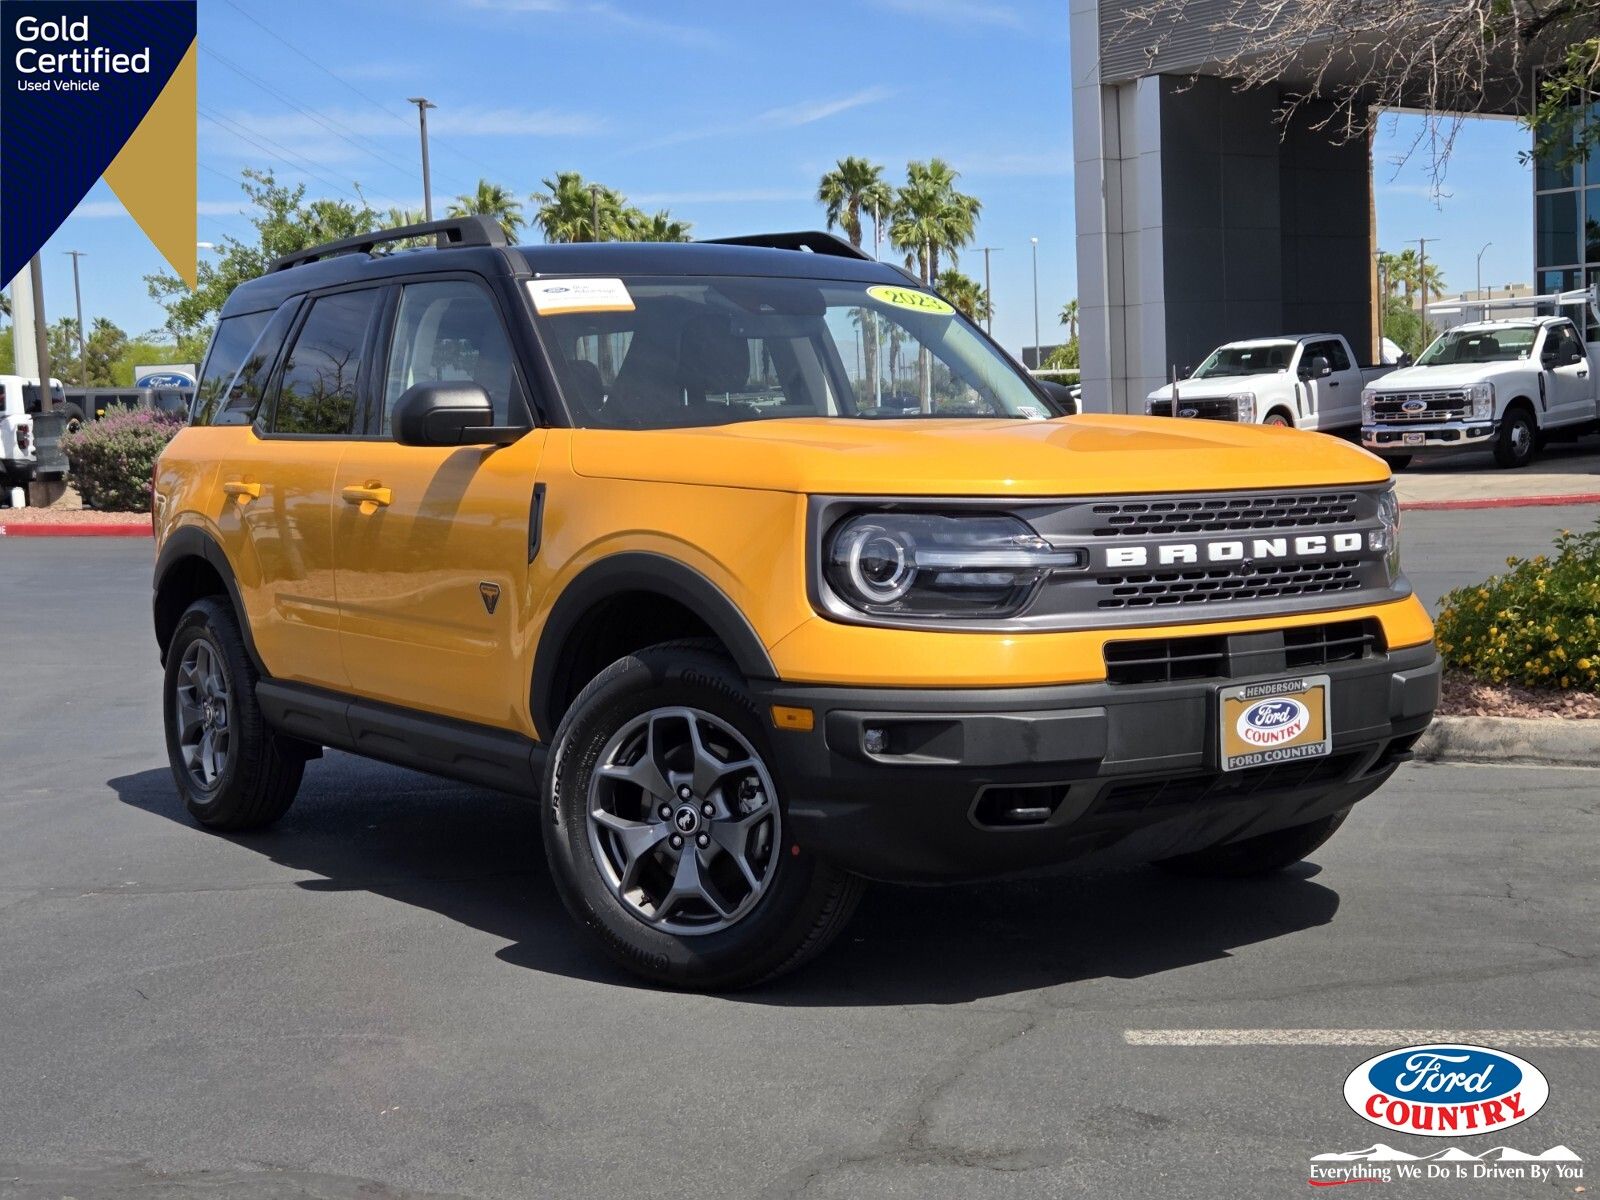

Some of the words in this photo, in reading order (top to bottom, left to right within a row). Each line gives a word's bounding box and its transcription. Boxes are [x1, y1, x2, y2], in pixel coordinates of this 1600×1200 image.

[1105, 532, 1363, 568] BRONCO
[1246, 680, 1302, 697] HENDERSON
[1254, 702, 1291, 726] Ford
[1244, 720, 1302, 743] COUNTRY
[1229, 753, 1263, 768] FORD
[1264, 743, 1325, 762] COUNTRY
